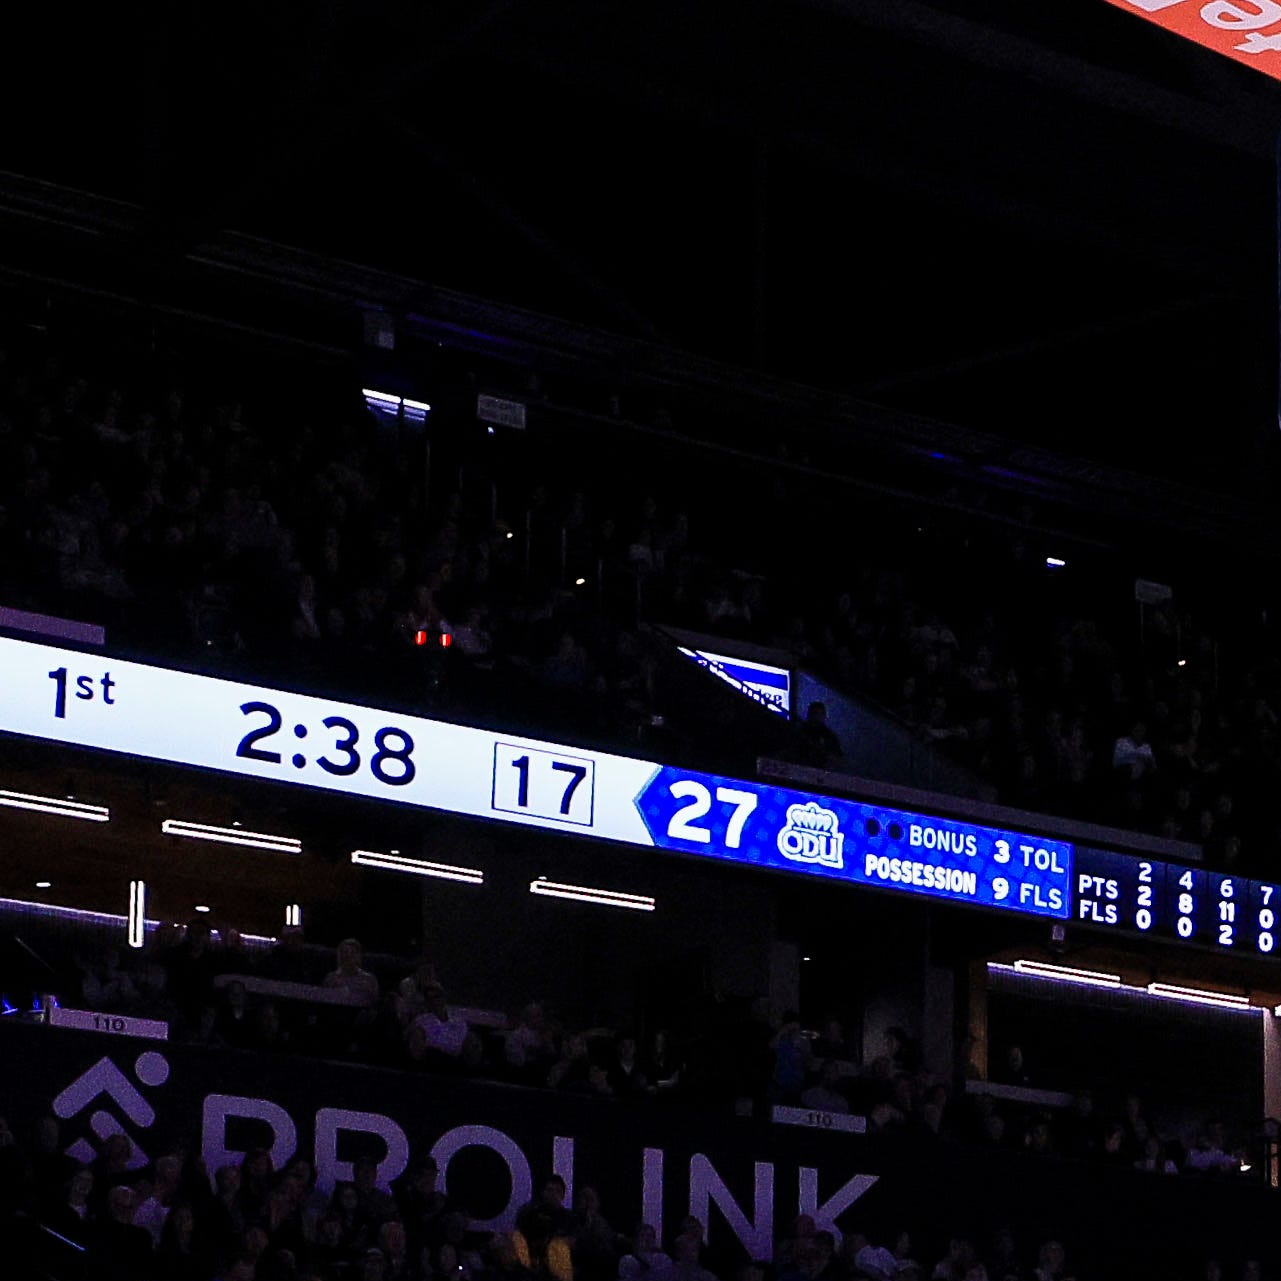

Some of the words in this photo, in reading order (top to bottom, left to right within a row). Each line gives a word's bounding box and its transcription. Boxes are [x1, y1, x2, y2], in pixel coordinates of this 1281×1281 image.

[48, 667, 117, 719] 1st
[235, 700, 417, 787] 2:38
[509, 755, 588, 815] 17
[666, 780, 758, 848] 27
[909, 825, 977, 857] BONUS
[993, 840, 1011, 863] 3
[1020, 844, 1064, 874] TOL
[865, 853, 976, 895] POSSESSION
[992, 877, 1009, 900] 9
[1020, 883, 1062, 910] FLS
[1138, 862, 1152, 882] 2
[1179, 871, 1193, 890] 4
[1220, 879, 1234, 898] 6
[1260, 886, 1274, 905] 7
[1078, 874, 1119, 900] PTS
[1137, 886, 1152, 906] 2
[1178, 893, 1194, 914] 8
[1219, 901, 1236, 922] 11
[1258, 909, 1274, 929] 0
[1078, 899, 1118, 924] FLS
[1136, 909, 1151, 930] 0
[1177, 917, 1193, 937] 0
[1219, 924, 1233, 945] 2
[1258, 932, 1274, 952] 0
